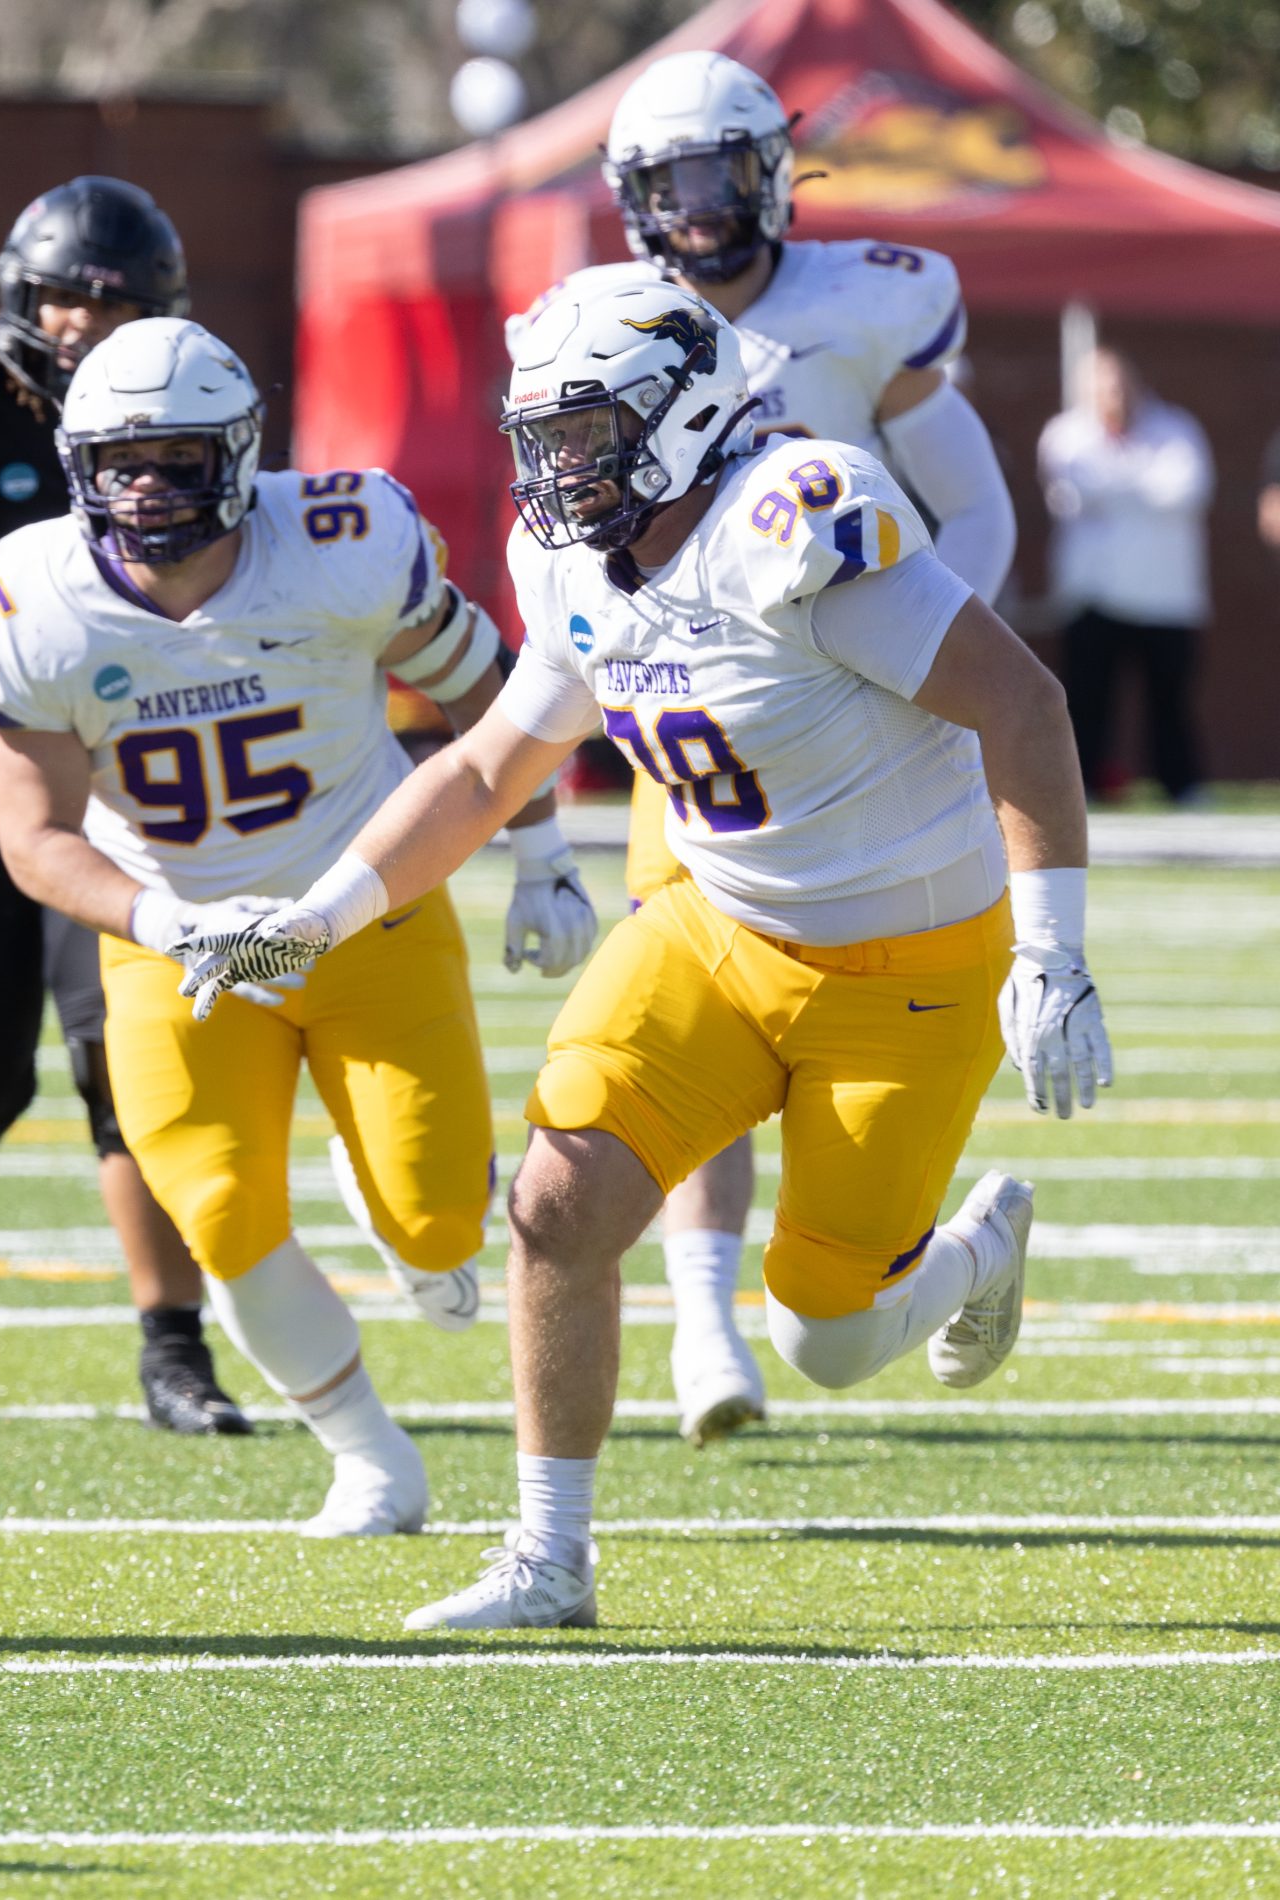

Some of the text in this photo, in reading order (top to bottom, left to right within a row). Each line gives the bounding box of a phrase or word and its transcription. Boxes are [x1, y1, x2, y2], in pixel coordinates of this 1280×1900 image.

[300, 471, 370, 545] 95
[748, 458, 845, 548] 98
[135, 673, 267, 721] MAVERICKS
[604, 658, 690, 694] MAVERICKS
[113, 703, 317, 849] 95
